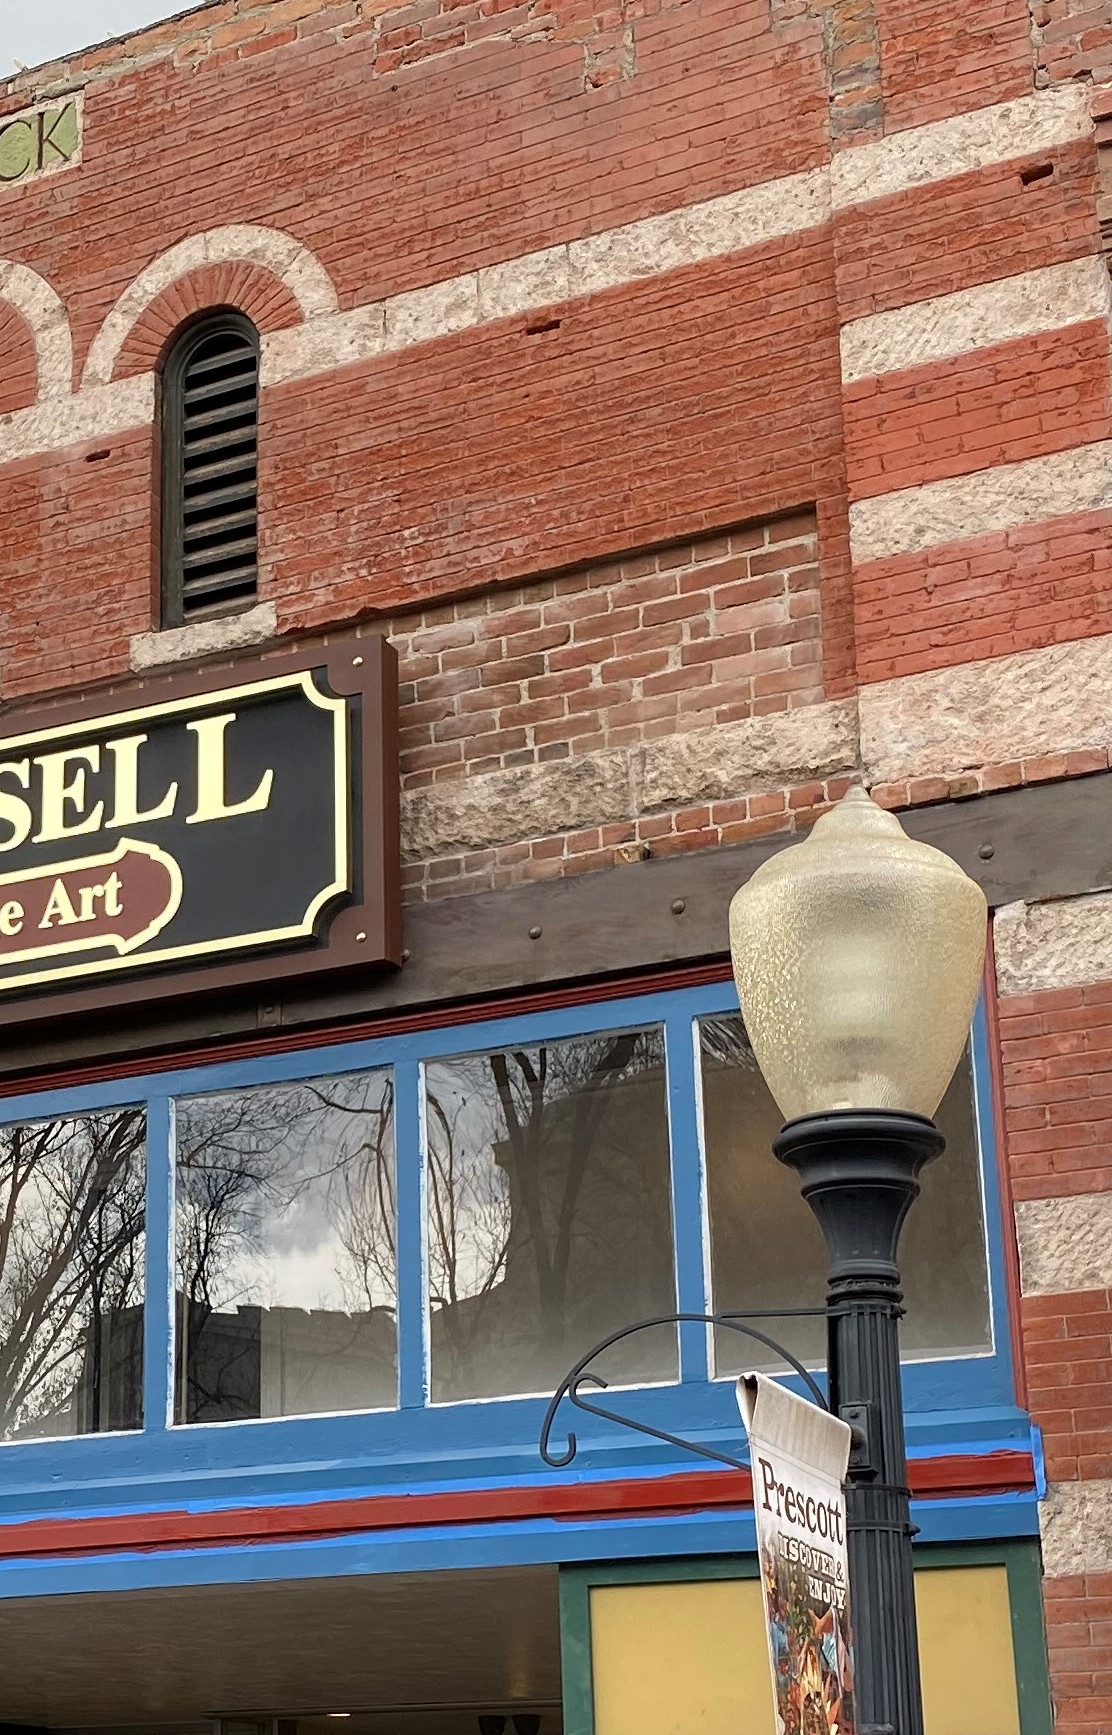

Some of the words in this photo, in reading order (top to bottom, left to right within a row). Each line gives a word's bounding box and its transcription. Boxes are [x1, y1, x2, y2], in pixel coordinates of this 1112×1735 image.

[38, 871, 124, 930] Art
[758, 1457, 844, 1546] Prescott
[777, 1531, 836, 1576] DISCOVER
[808, 1575, 846, 1610] ENJOY
